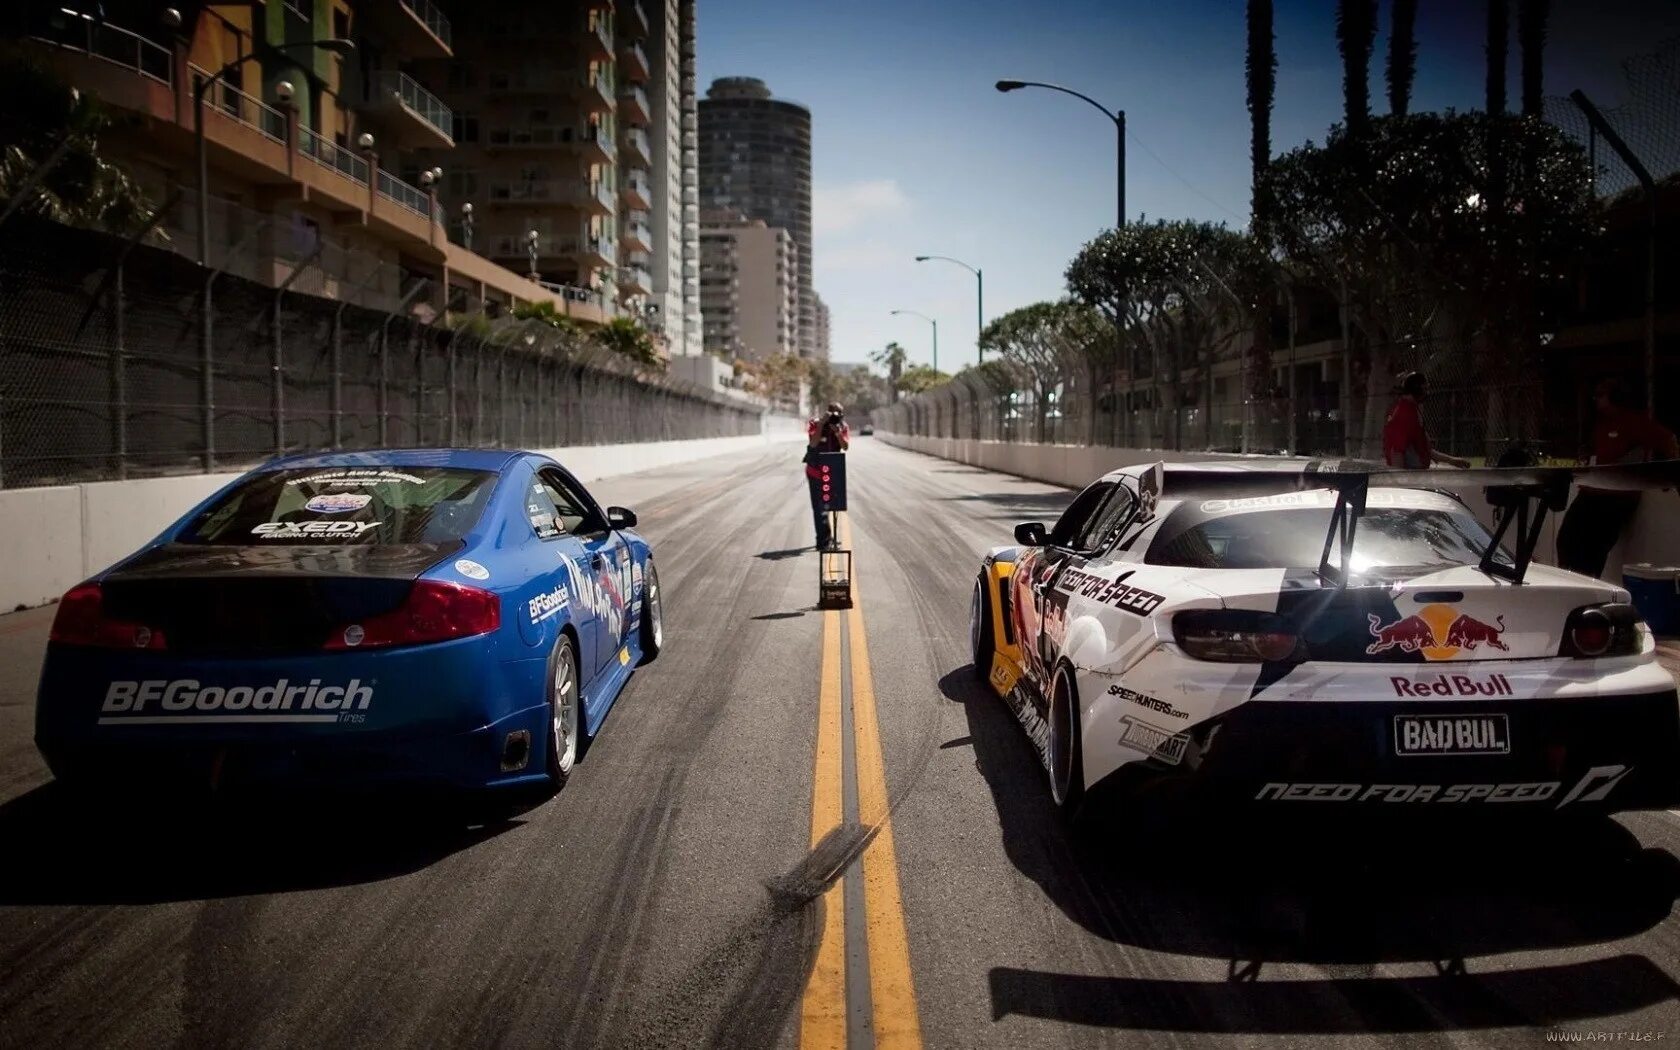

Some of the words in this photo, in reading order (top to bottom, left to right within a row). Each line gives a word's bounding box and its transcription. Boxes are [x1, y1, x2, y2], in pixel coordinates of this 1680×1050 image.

[251, 521, 383, 534] EXEDY
[1079, 574, 1109, 599] FOR
[1097, 576, 1166, 617] SPEED
[101, 679, 374, 711] BFGoodrich
[1389, 674, 1451, 697] Red
[1456, 674, 1514, 696] Bull
[339, 711, 365, 723] Tires
[1404, 720, 1454, 750] BAD
[1254, 782, 1361, 801] NEED
[1357, 783, 1440, 803] FOR
[1437, 782, 1561, 803] SPEED
